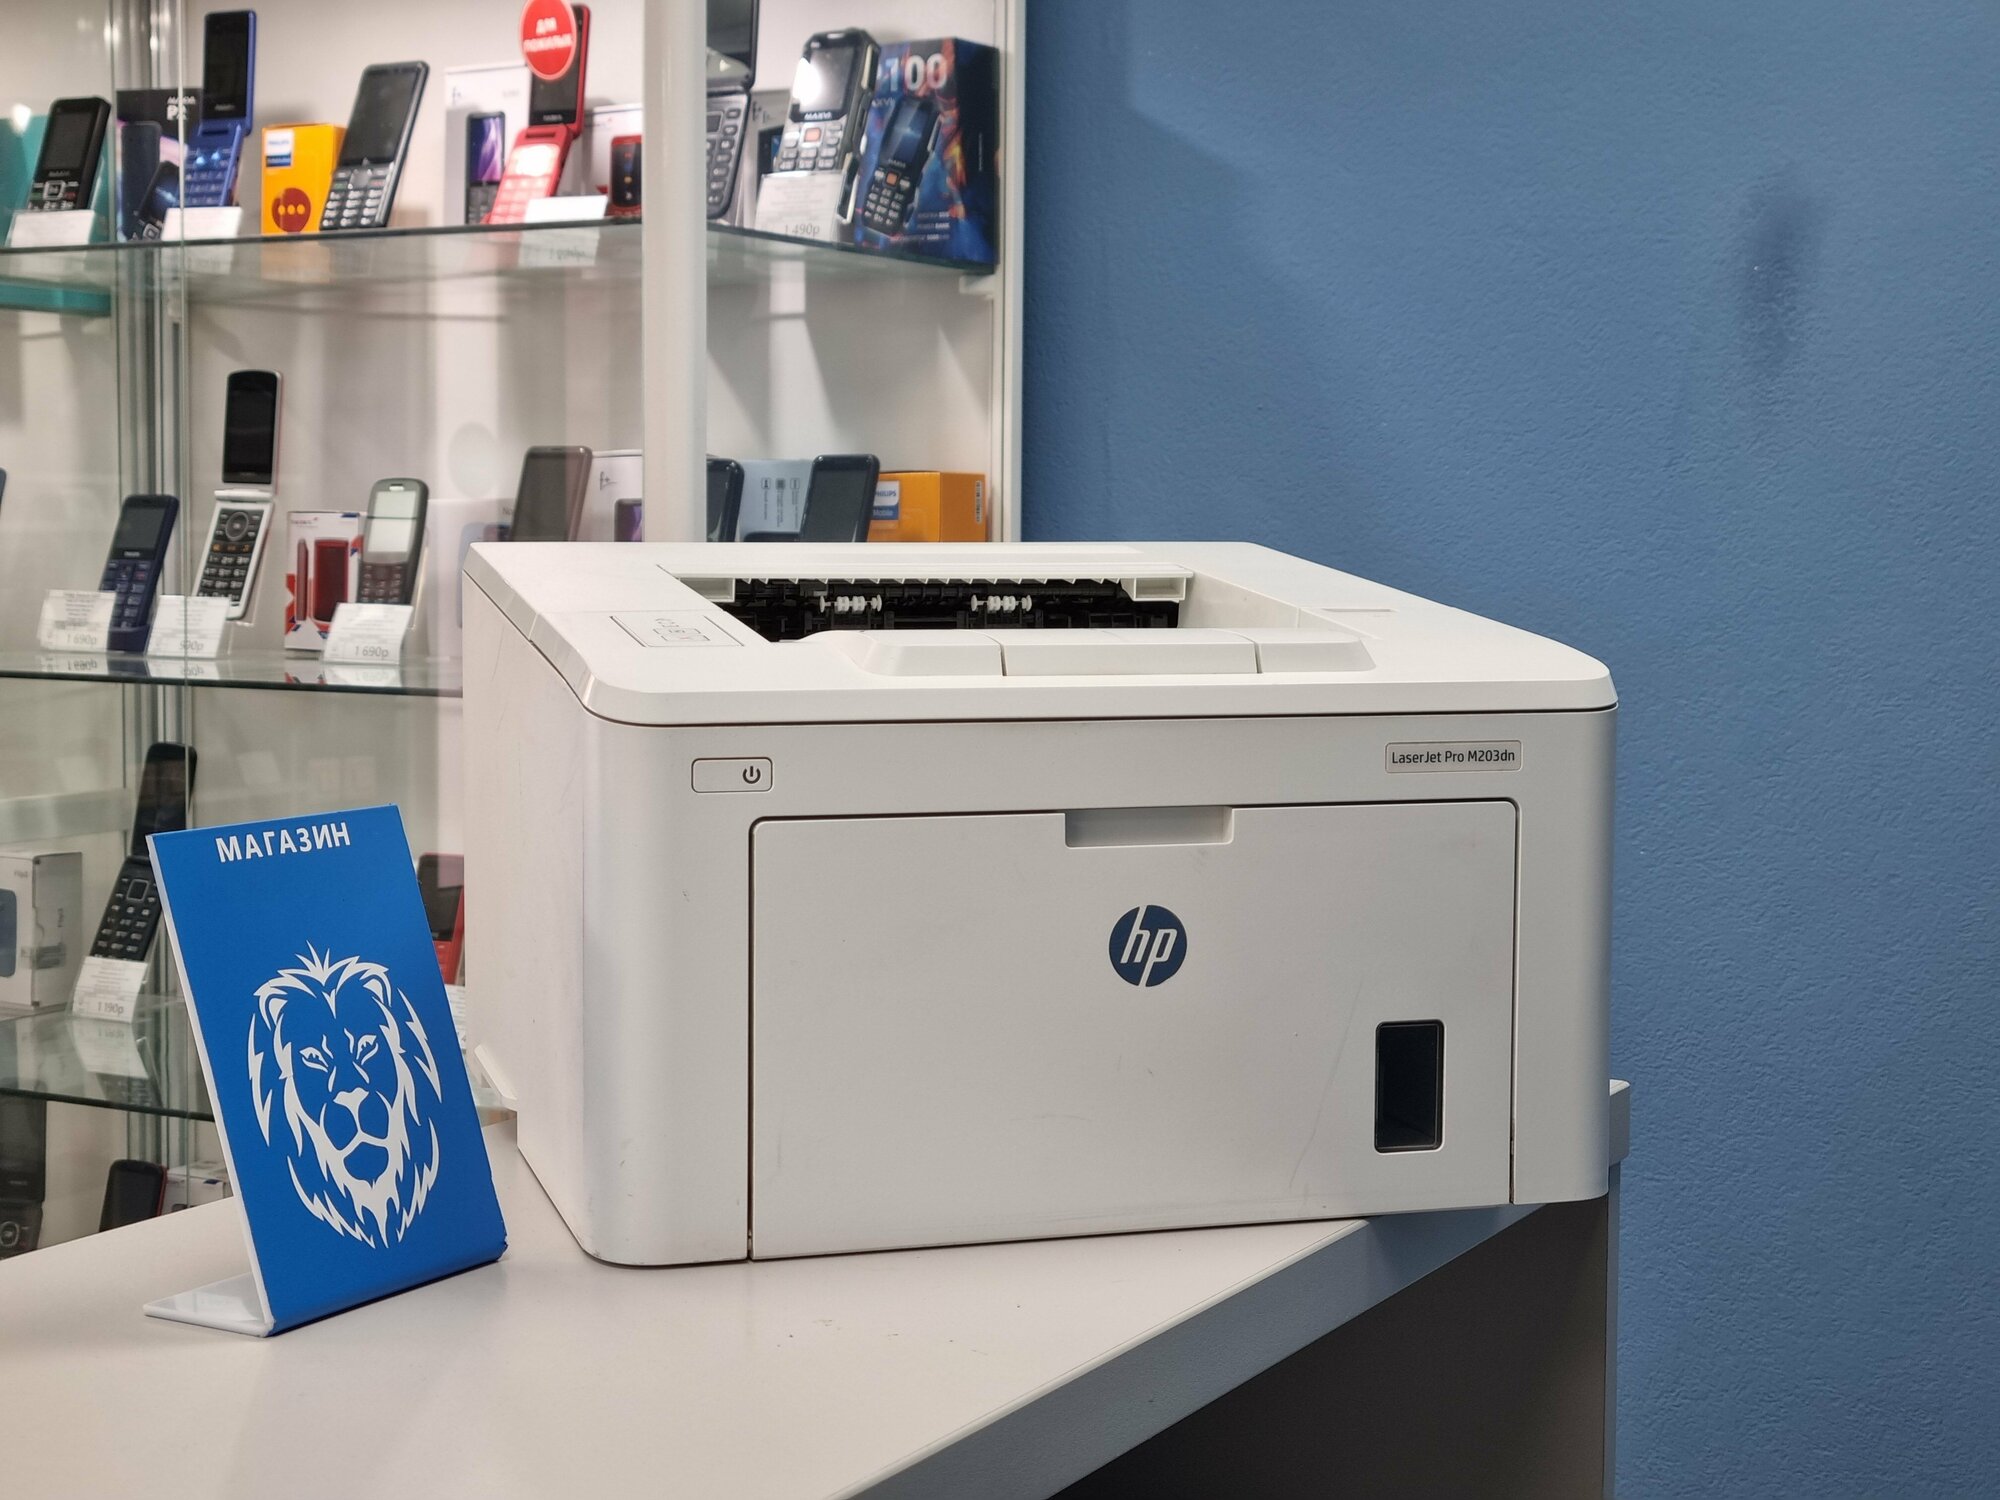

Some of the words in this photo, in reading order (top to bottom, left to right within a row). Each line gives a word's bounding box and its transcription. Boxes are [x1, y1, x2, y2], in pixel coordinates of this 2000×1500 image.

[1392, 751, 1441, 763] LaserJet
[1444, 750, 1464, 762] Pro
[1467, 749, 1515, 762] M203dn
[215, 822, 350, 862] МАГАЗИН
[1119, 905, 1178, 986] hp
